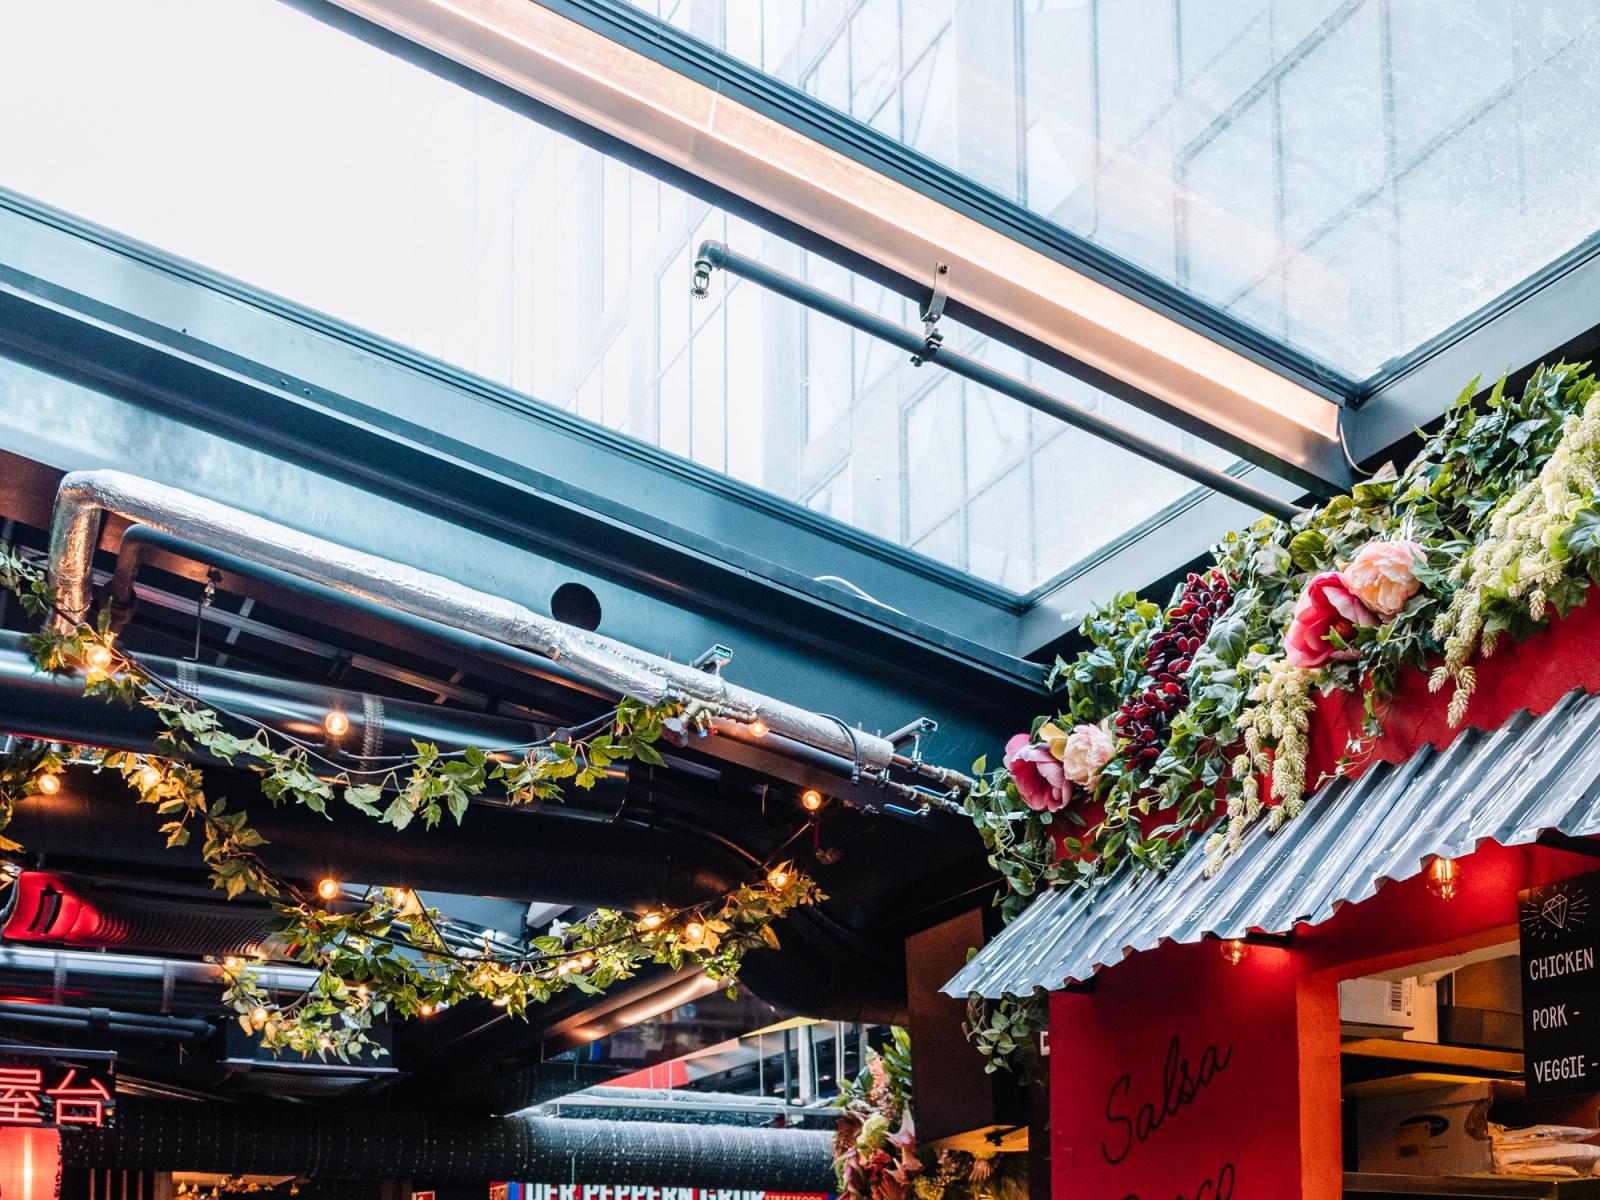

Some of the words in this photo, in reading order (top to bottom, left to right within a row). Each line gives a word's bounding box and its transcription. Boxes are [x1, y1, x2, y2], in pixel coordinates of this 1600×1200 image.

[1529, 947, 1595, 981] CHICKEN
[1532, 1003, 1568, 1031] PORK
[1533, 1055, 1587, 1085] VEGGIE
[1101, 1035, 1233, 1166] Salsa
